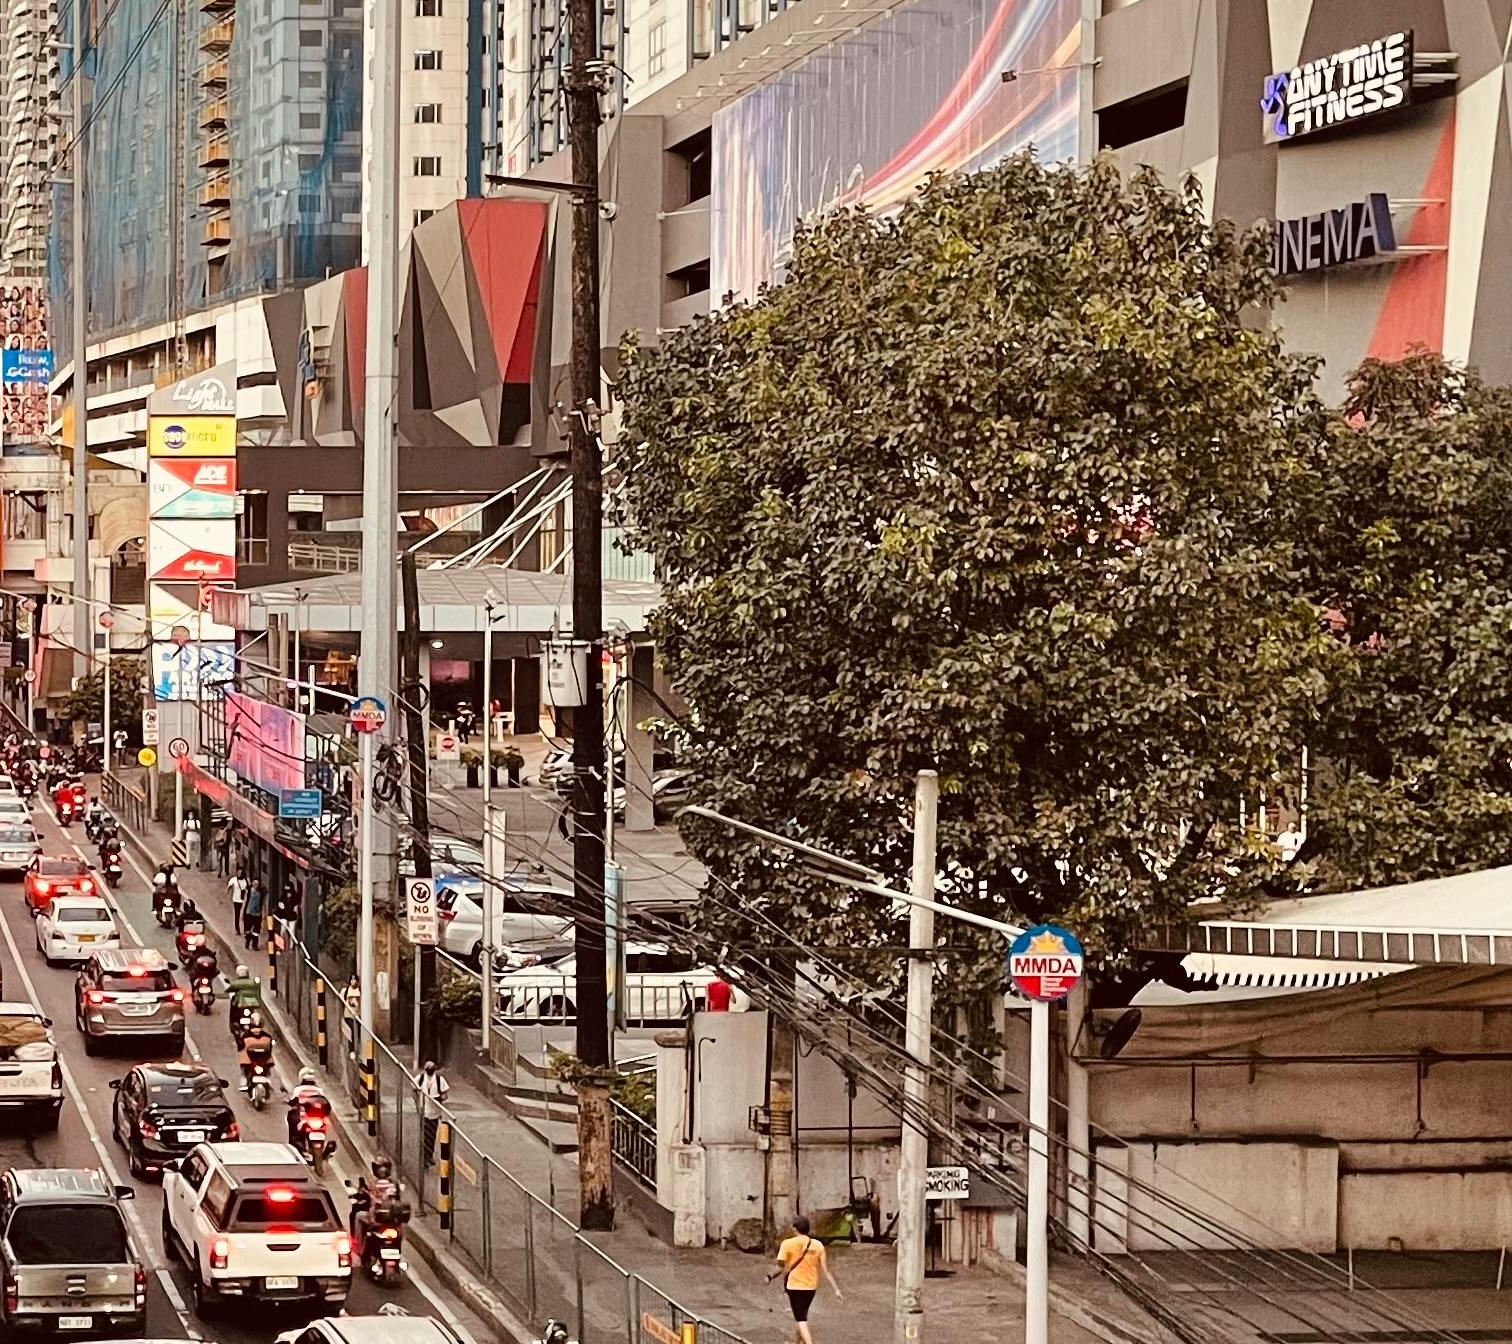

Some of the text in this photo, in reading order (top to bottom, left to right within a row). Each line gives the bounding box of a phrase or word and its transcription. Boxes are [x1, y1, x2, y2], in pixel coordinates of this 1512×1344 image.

[1287, 32, 1405, 104] ANYTIME
[1287, 71, 1405, 136] FITNESS
[1273, 193, 1387, 275] INEMA
[414, 905, 430, 914] NO
[1014, 957, 1077, 974] MMDA
